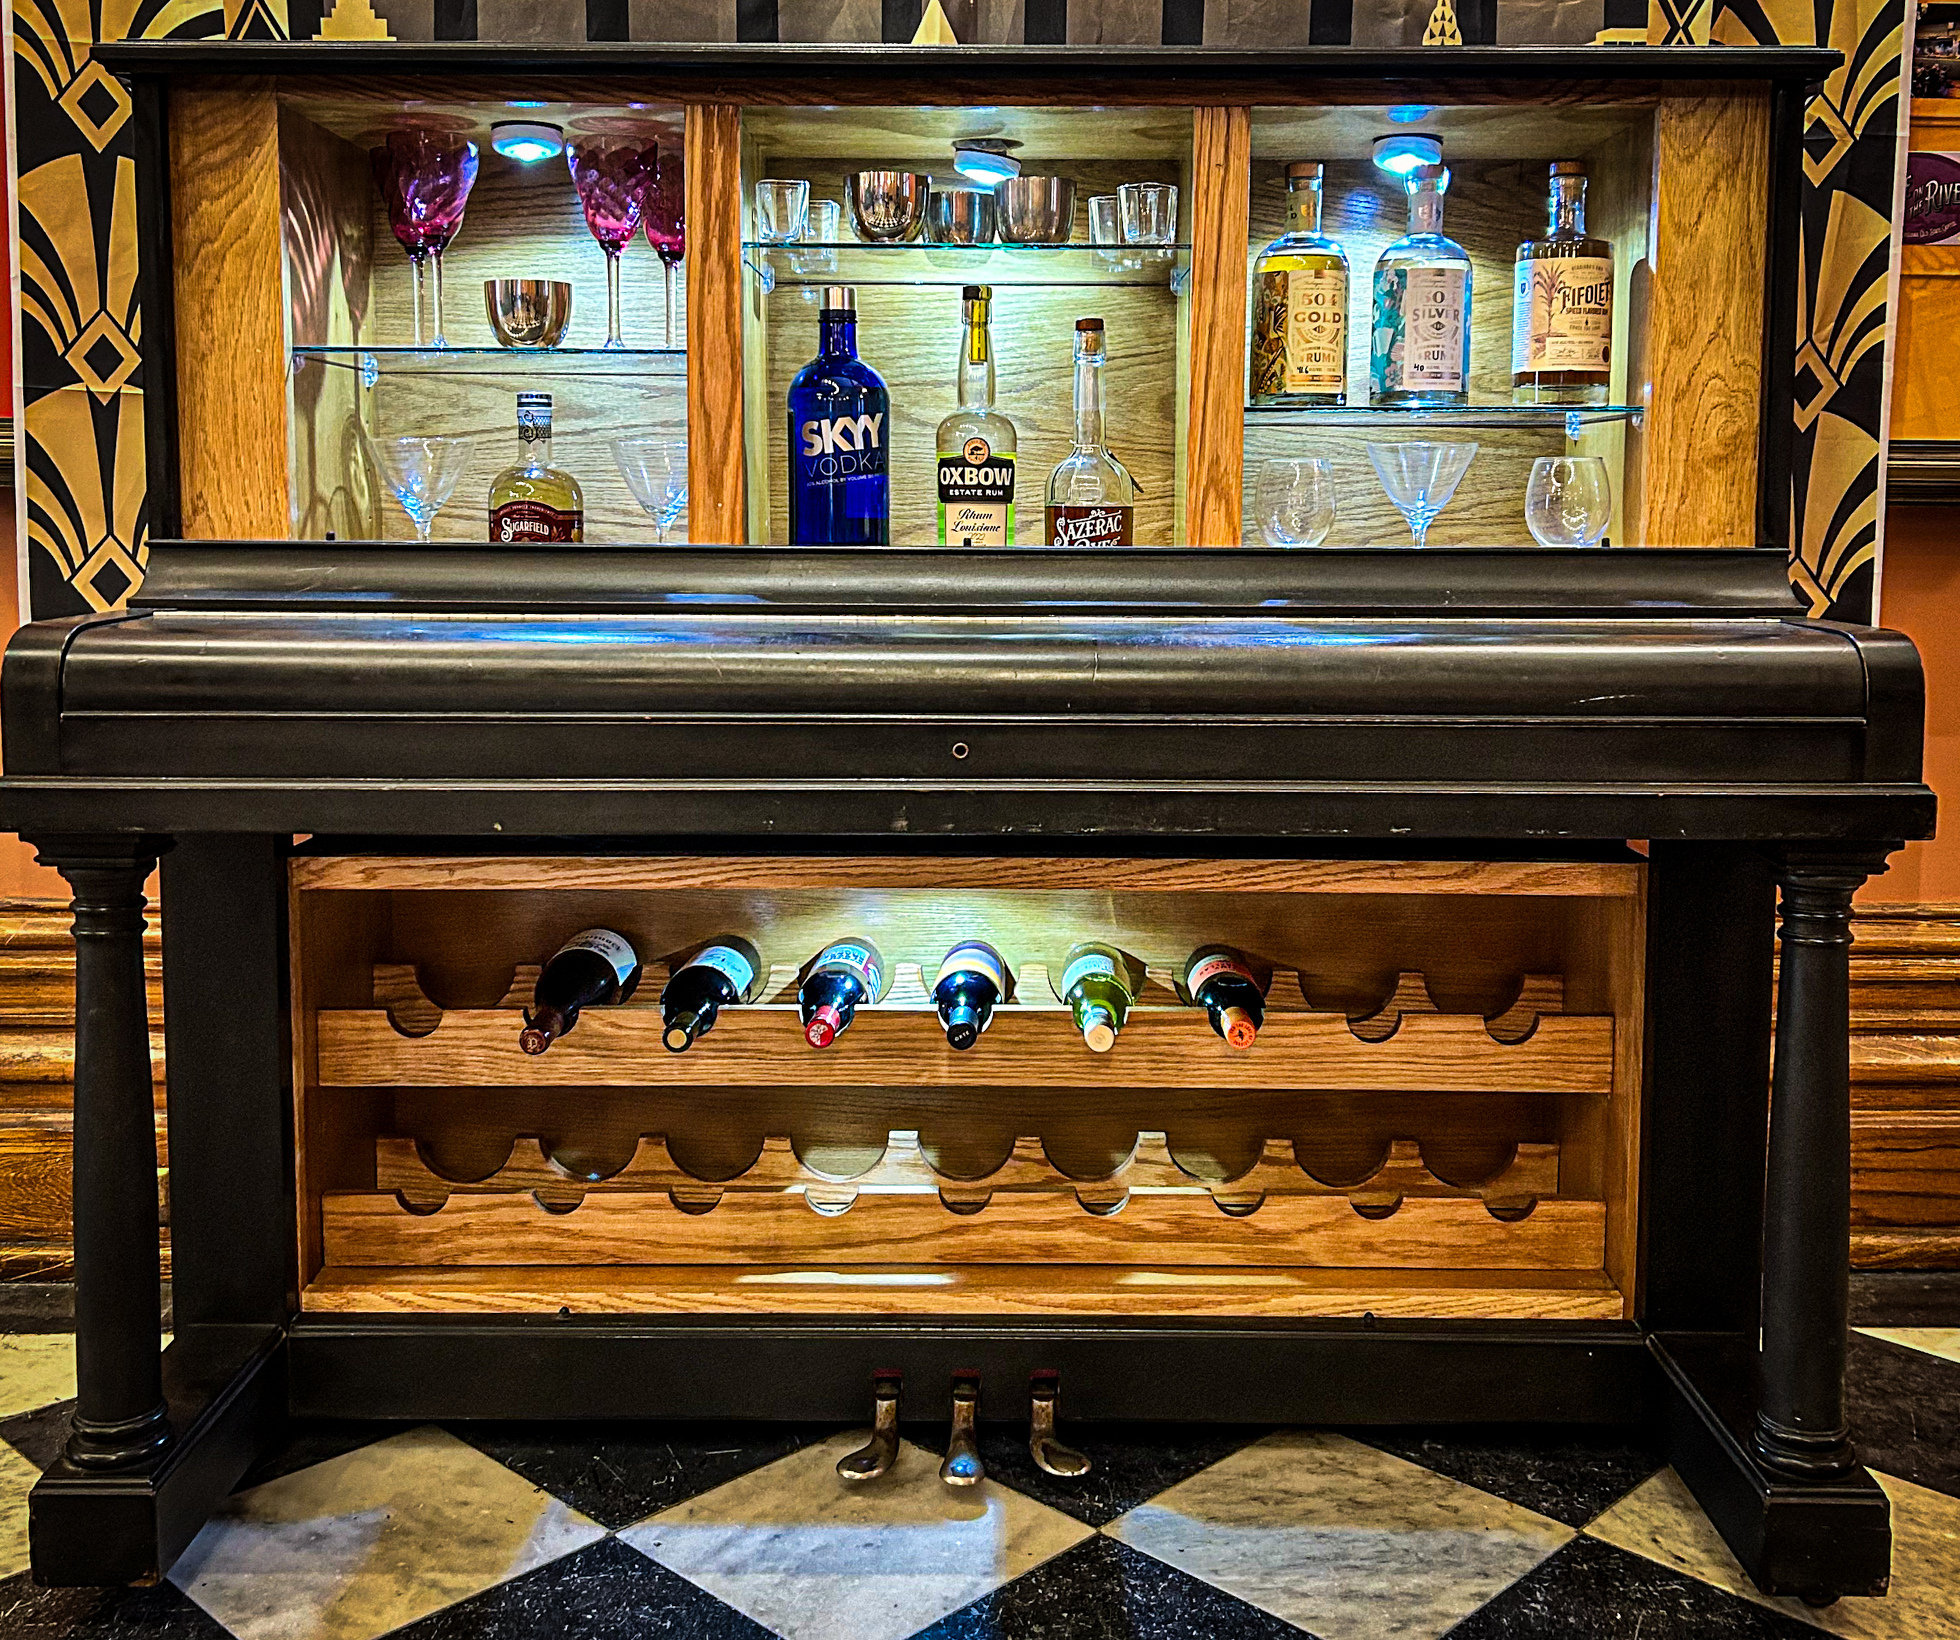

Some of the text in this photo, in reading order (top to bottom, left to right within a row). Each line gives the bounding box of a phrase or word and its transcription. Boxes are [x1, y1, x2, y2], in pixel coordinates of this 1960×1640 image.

[1556, 280, 1611, 314] FIFOLET
[1293, 311, 1342, 324] GOLD
[1412, 307, 1460, 321] SILVER
[1306, 352, 1331, 363] RUM
[802, 412, 884, 457] SKYY
[804, 450, 885, 478] VODKA
[940, 466, 1013, 487] OXBOW
[949, 488, 1004, 496] ESTATE RUM
[957, 508, 993, 520] Rhum
[501, 517, 550, 542] SUGARFIELD
[1054, 515, 1123, 546] SAZERAC
